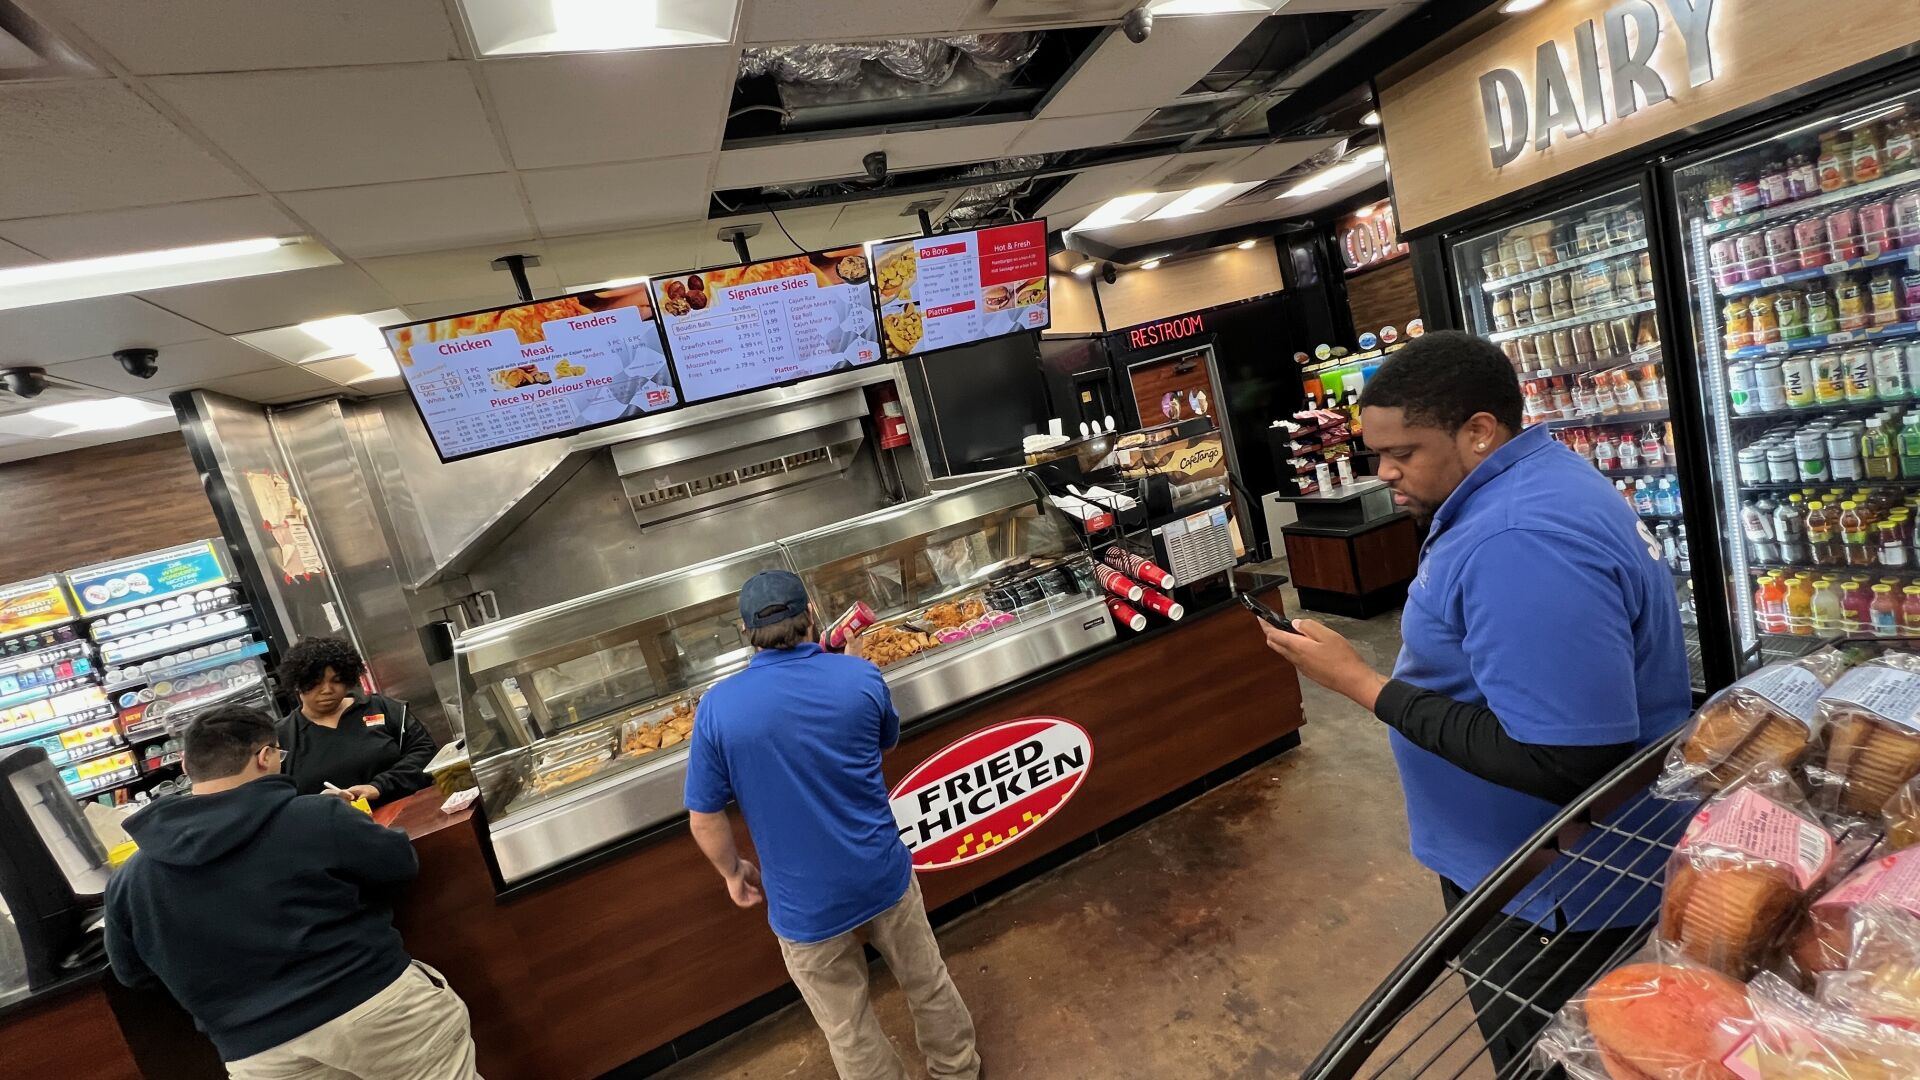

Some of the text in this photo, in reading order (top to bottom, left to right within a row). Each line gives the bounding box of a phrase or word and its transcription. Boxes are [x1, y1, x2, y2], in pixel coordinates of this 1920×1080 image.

[1479, 0, 1714, 168] DAIRY
[921, 245, 948, 257] Po Boys
[994, 243, 1005, 251] Hot
[1014, 239, 1030, 248] Fresh
[727, 277, 809, 303] Signature Sides
[927, 305, 953, 317] Platters
[567, 312, 617, 332] Tenders
[674, 322, 697, 332] Boudin
[1130, 314, 1204, 349] RESTROOM
[677, 334, 691, 342] Fish
[437, 335, 493, 357] Chicken
[519, 343, 554, 358] Meals
[581, 350, 605, 360] Tenders
[486, 364, 504, 372] Served
[527, 355, 544, 364] choice
[549, 352, 562, 360] fries
[685, 358, 717, 370] Mozzarella
[773, 364, 798, 373] Platters
[419, 382, 435, 390] Dark
[489, 394, 521, 408] Piece
[520, 390, 536, 403] by
[536, 379, 584, 399] Delicious
[584, 374, 613, 388] Piece
[422, 390, 436, 398] Mix
[425, 395, 446, 405] White
[918, 740, 1043, 815] FRIED
[898, 745, 1084, 849] CHICKEN
